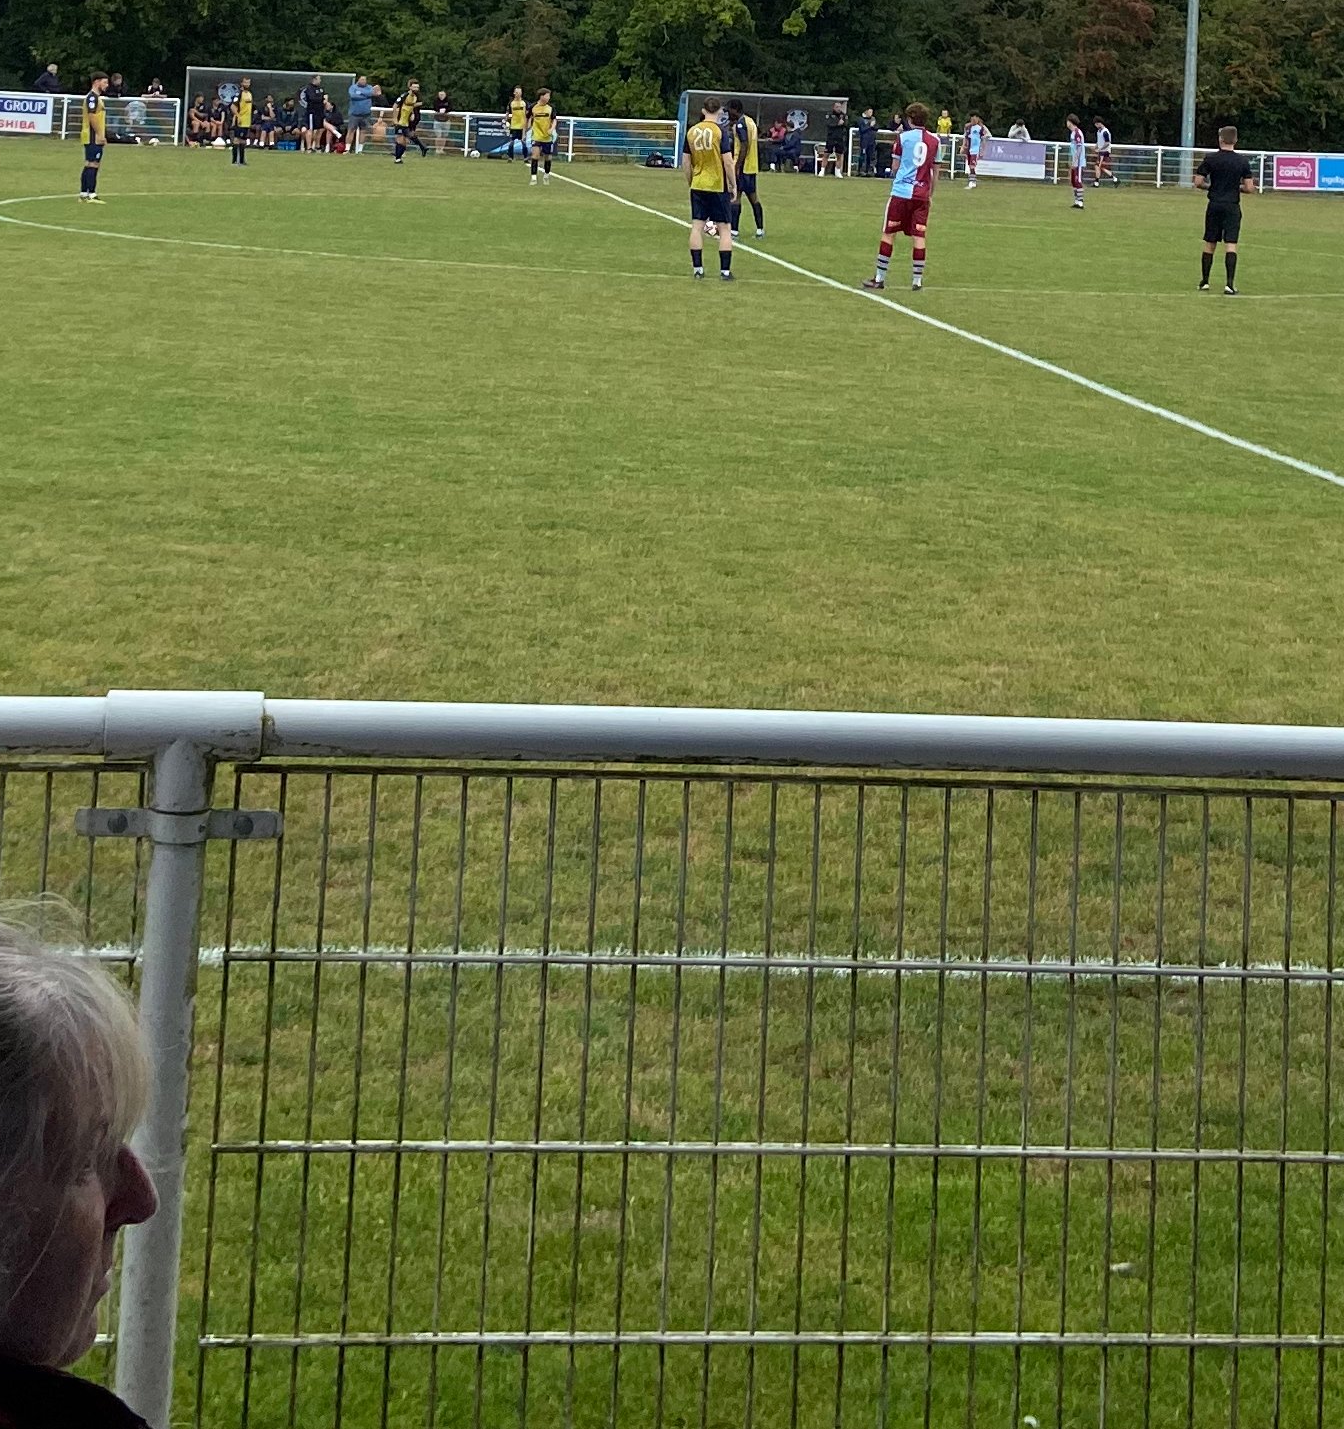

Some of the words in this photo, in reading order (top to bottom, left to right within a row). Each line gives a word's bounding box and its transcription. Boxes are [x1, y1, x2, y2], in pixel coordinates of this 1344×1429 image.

[3, 100, 45, 113] GROUP
[694, 127, 713, 151] 20
[913, 141, 928, 167] 9
